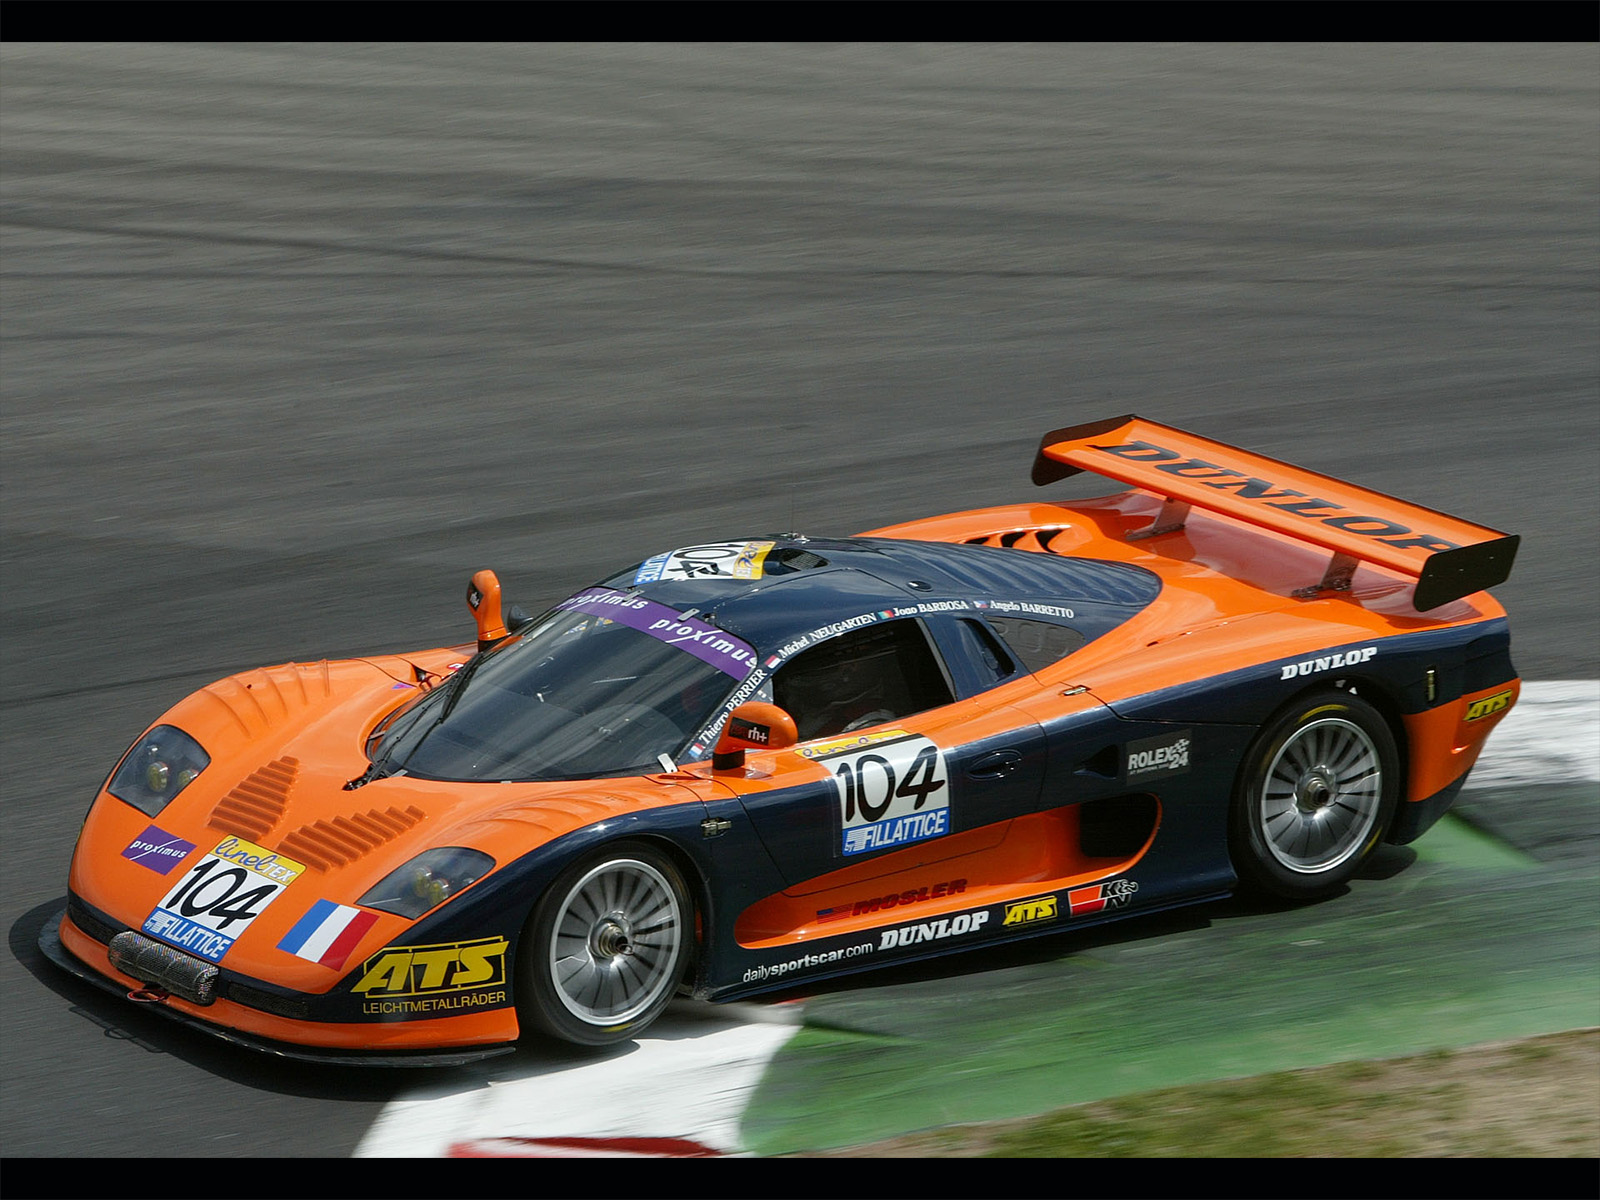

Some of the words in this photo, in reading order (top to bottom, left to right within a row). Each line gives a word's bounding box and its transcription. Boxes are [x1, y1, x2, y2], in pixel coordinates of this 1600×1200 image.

[1086, 440, 1463, 553] DUNLOP
[555, 590, 648, 610] proximus
[917, 600, 969, 613] BARBOSA
[990, 600, 1020, 613] Angelo
[1020, 602, 1074, 618] BARRETTO
[648, 617, 756, 669] proximus
[777, 636, 810, 660] Michel
[809, 612, 878, 642] NEUGARTEN
[1280, 647, 1378, 680] DUNLOP
[725, 668, 767, 712] PERRIER
[1463, 690, 1513, 721] ATS
[1128, 746, 1174, 770] ROLEX
[1168, 751, 1189, 770] 24
[836, 745, 945, 822] 104
[129, 838, 187, 860] proximus
[854, 809, 947, 850] FILLATTICE
[166, 858, 278, 930] 104
[852, 878, 967, 916] MOSLER
[1002, 897, 1058, 926] ATS
[152, 914, 231, 959] FILLATTICE
[878, 910, 990, 951] DUNLOP
[351, 939, 510, 993] ATS
[743, 942, 873, 983] dailysportscar.com
[363, 991, 506, 1014] LEICHTMETALLRÄDER
